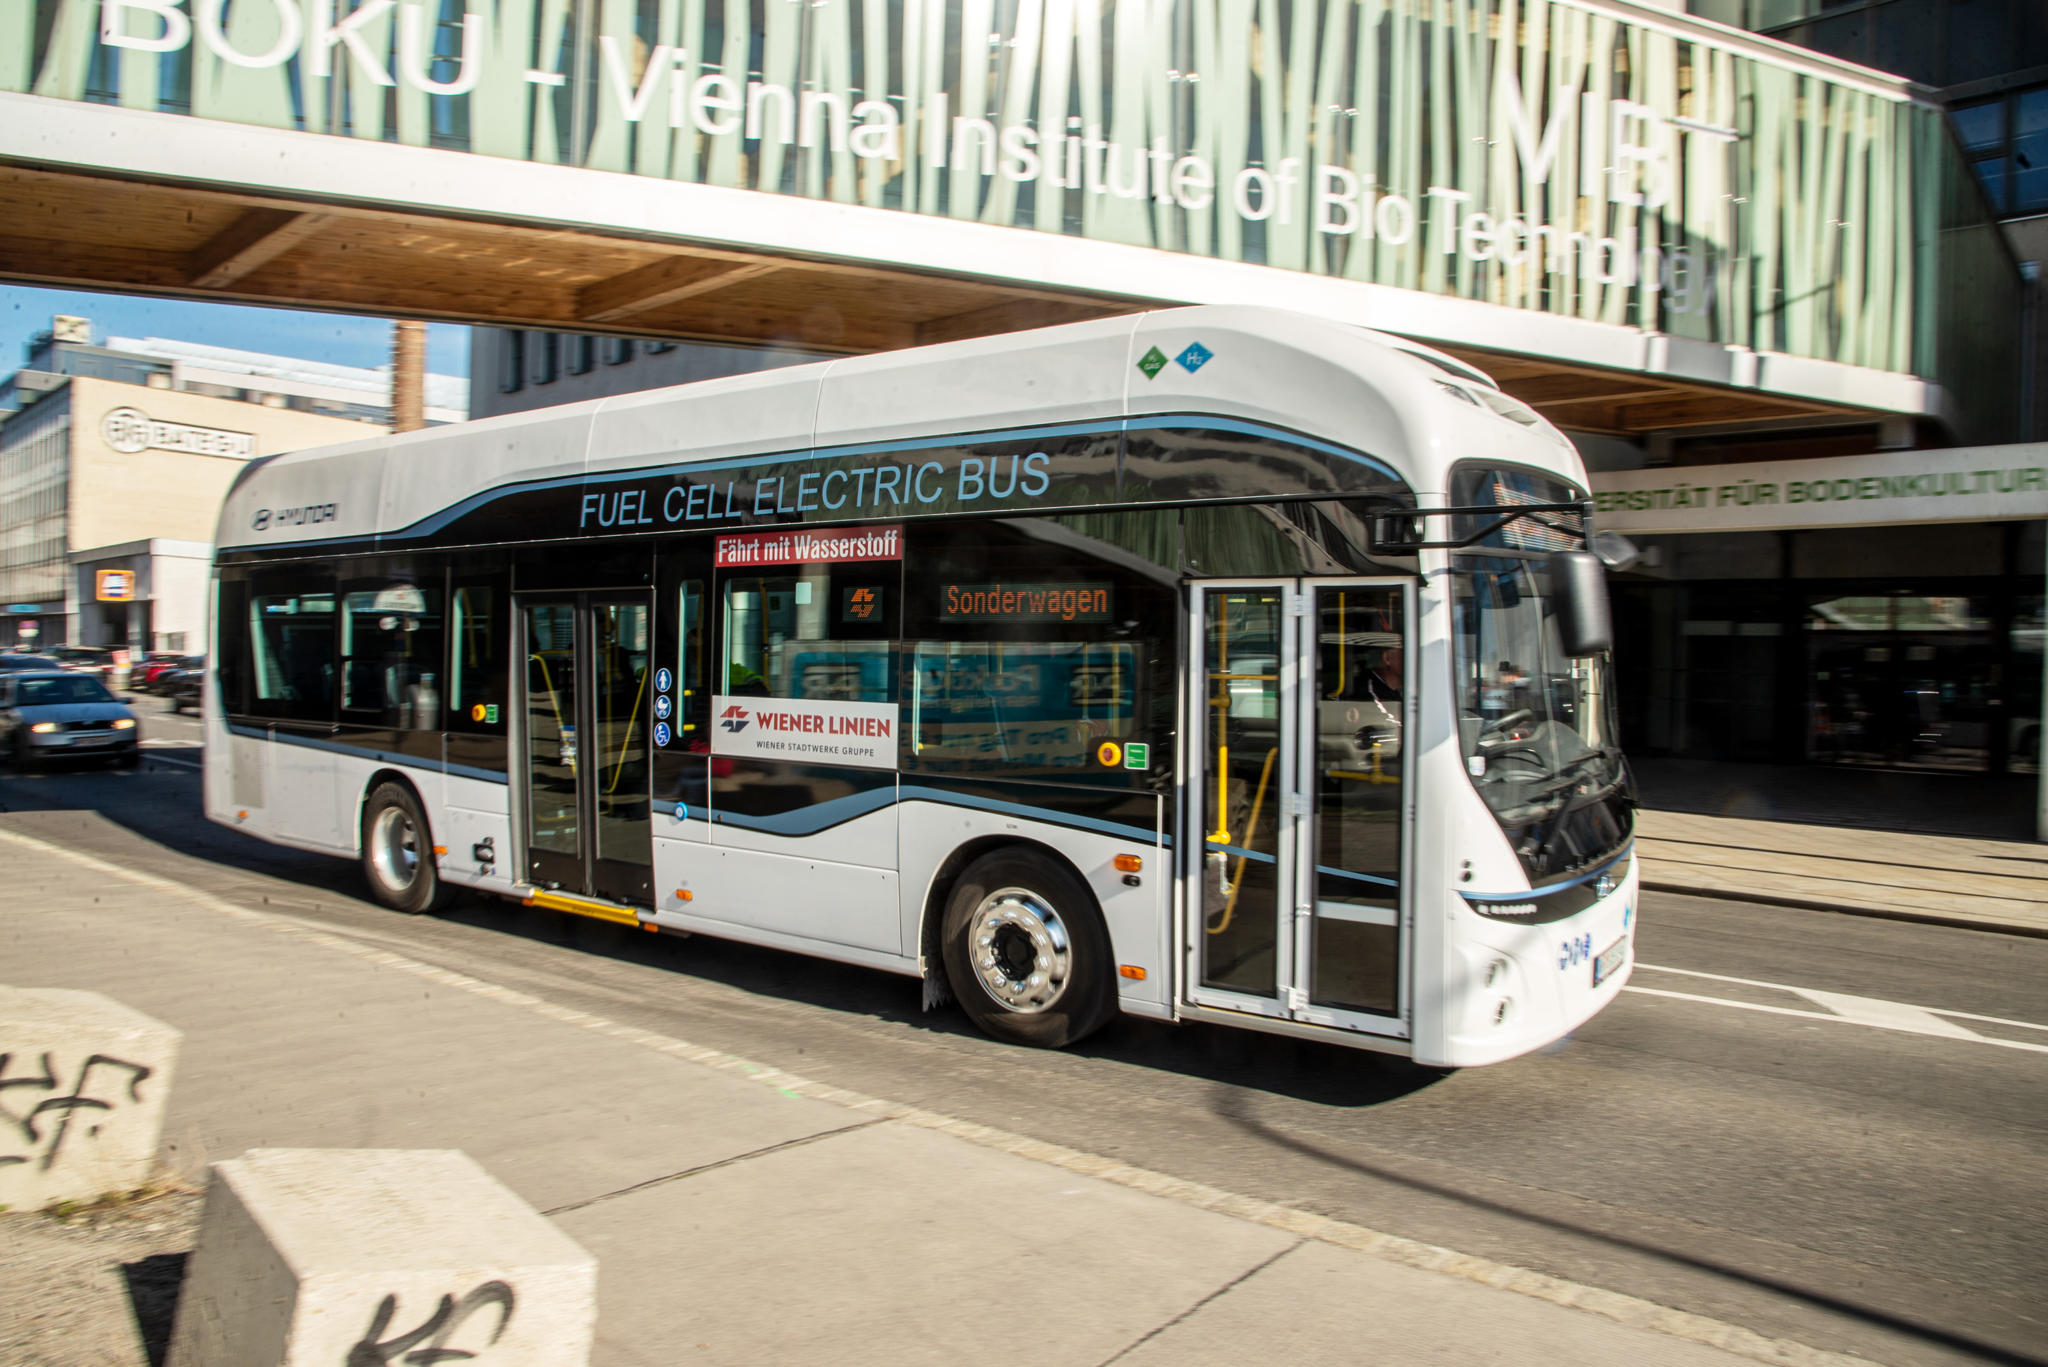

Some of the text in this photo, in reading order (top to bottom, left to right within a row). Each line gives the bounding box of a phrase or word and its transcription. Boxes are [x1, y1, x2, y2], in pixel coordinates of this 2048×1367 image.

[599, 35, 899, 161] Vienna
[927, 92, 1216, 211] Institute
[1233, 157, 1301, 225] of
[1316, 164, 1414, 246] Bio
[579, 452, 1051, 528] FUEL CELL ELECTRIC BUS
[1715, 478, 1780, 508] FÜR
[1785, 467, 2047, 505] BODENKULTUR
[717, 529, 898, 564] Fährt mit Wasserstoff
[946, 583, 1108, 621] Sonderwagen
[756, 711, 891, 739] WIENER LINIEN
[756, 740, 875, 758] WIENER STADTWERKE GRUPPE
